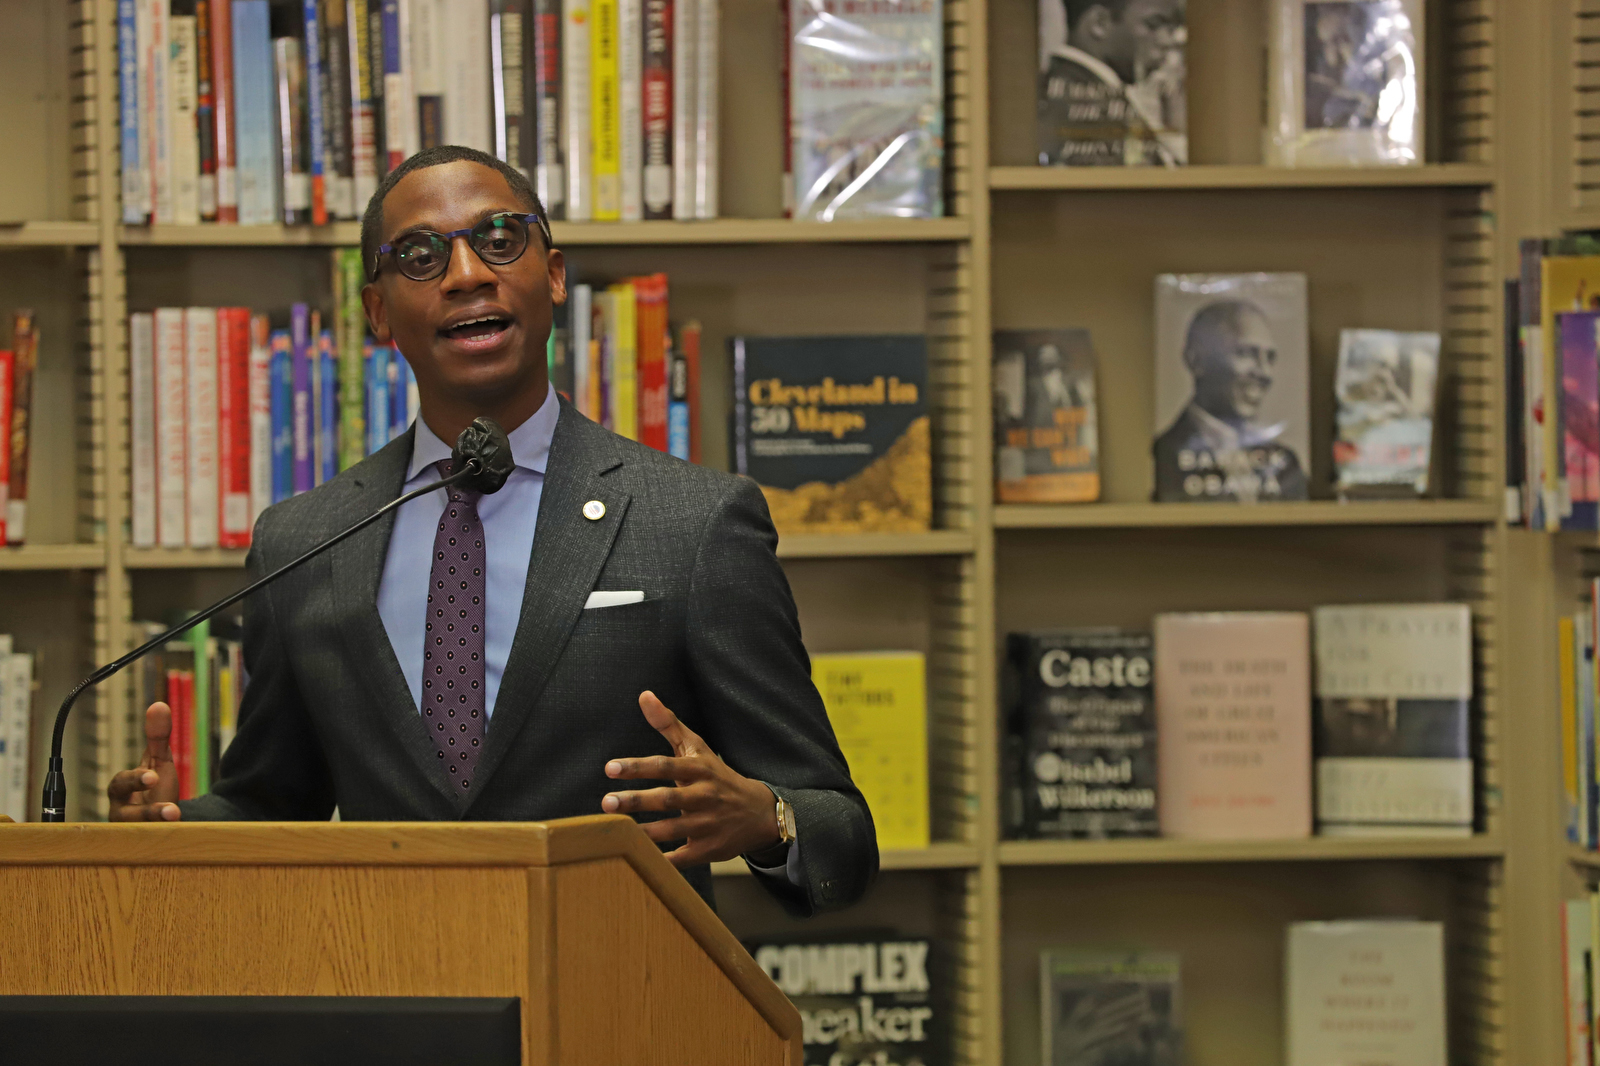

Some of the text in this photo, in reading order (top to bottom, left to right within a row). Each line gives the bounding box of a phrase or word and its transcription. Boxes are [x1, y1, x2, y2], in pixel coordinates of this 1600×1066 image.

[749, 376, 919, 407] Cleveland in
[751, 406, 866, 439] 50 Maps
[1178, 449, 1288, 472] BARACK
[1183, 474, 1282, 497] OBAMA
[1040, 649, 1151, 688] Caste
[1061, 757, 1132, 784] Isabel
[1037, 785, 1155, 810] Wilkerson
[755, 940, 930, 995] COMPLEX
